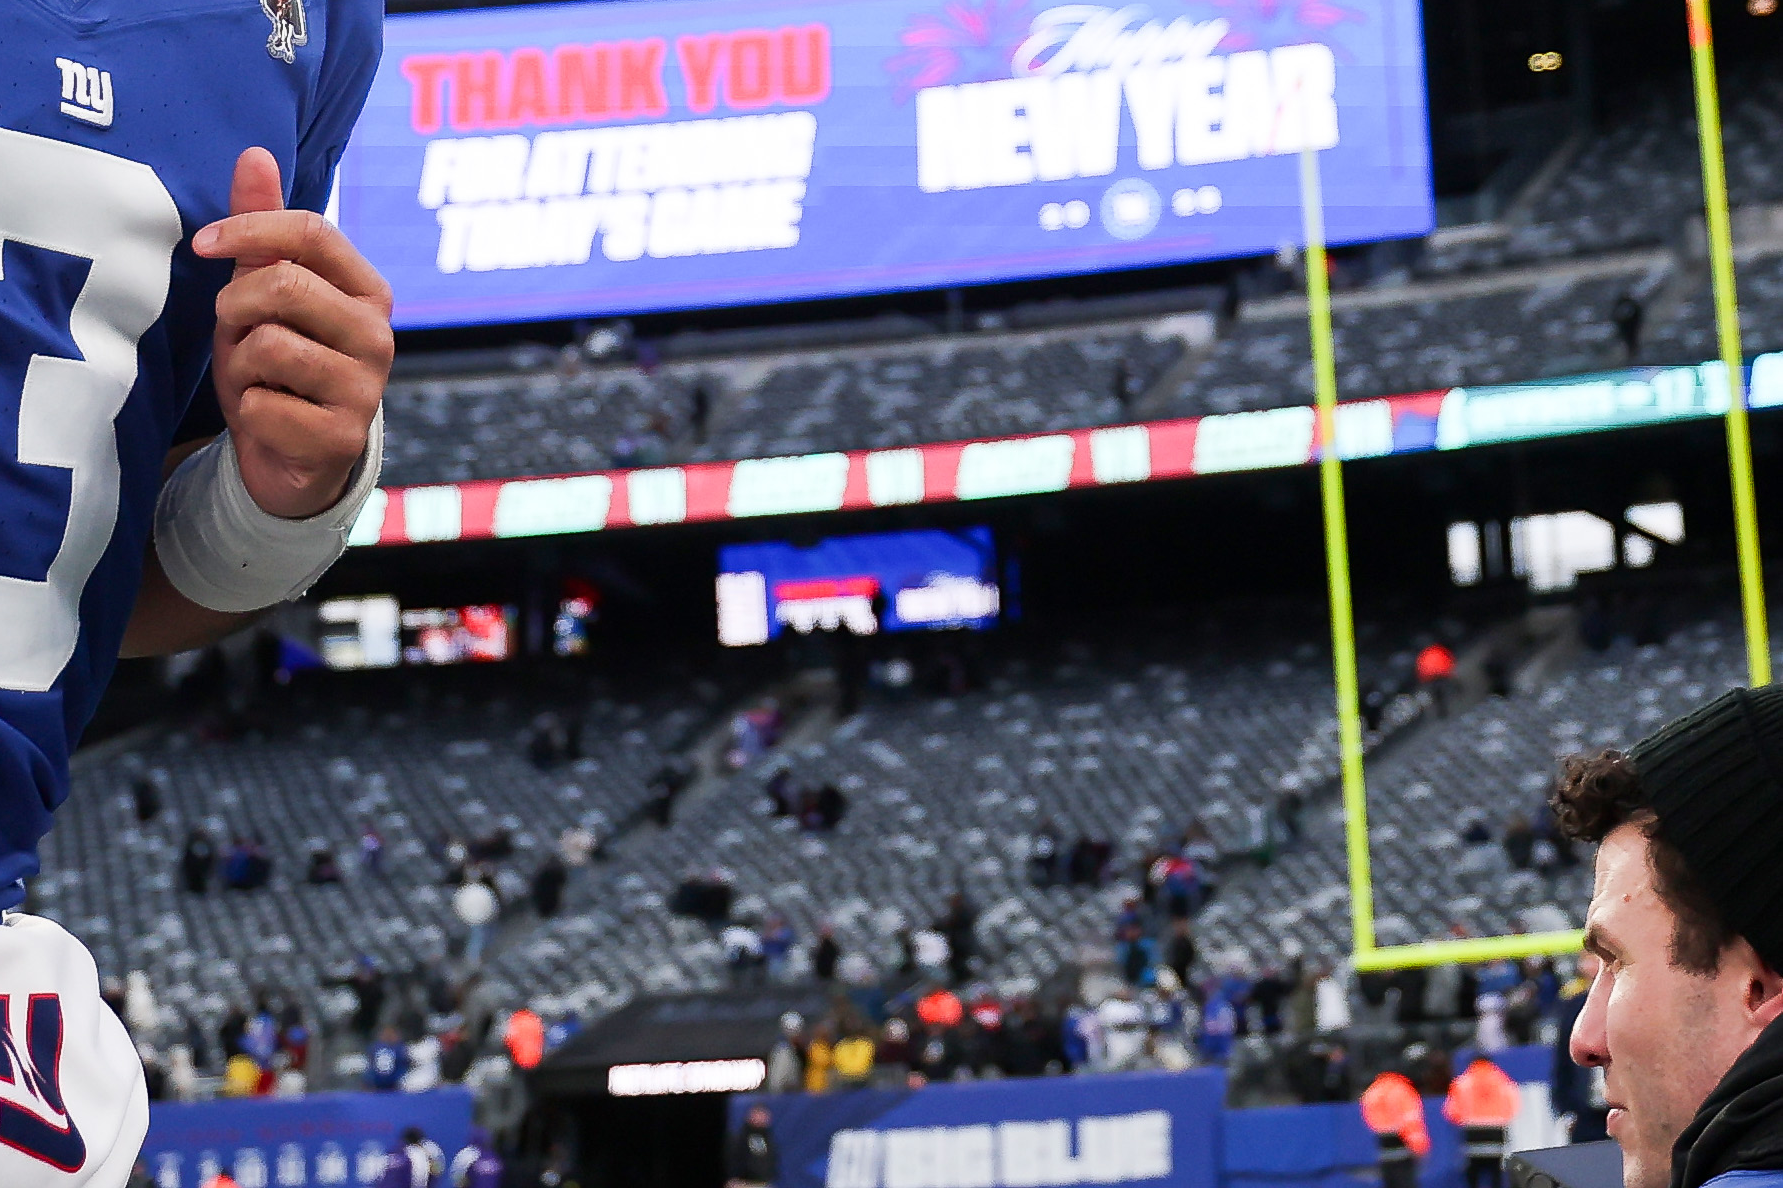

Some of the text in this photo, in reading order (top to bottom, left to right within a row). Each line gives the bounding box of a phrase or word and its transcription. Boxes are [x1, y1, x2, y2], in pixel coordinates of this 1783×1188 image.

[402, 22, 832, 135] THANK YOU
[916, 41, 1340, 193] NEW YEAR
